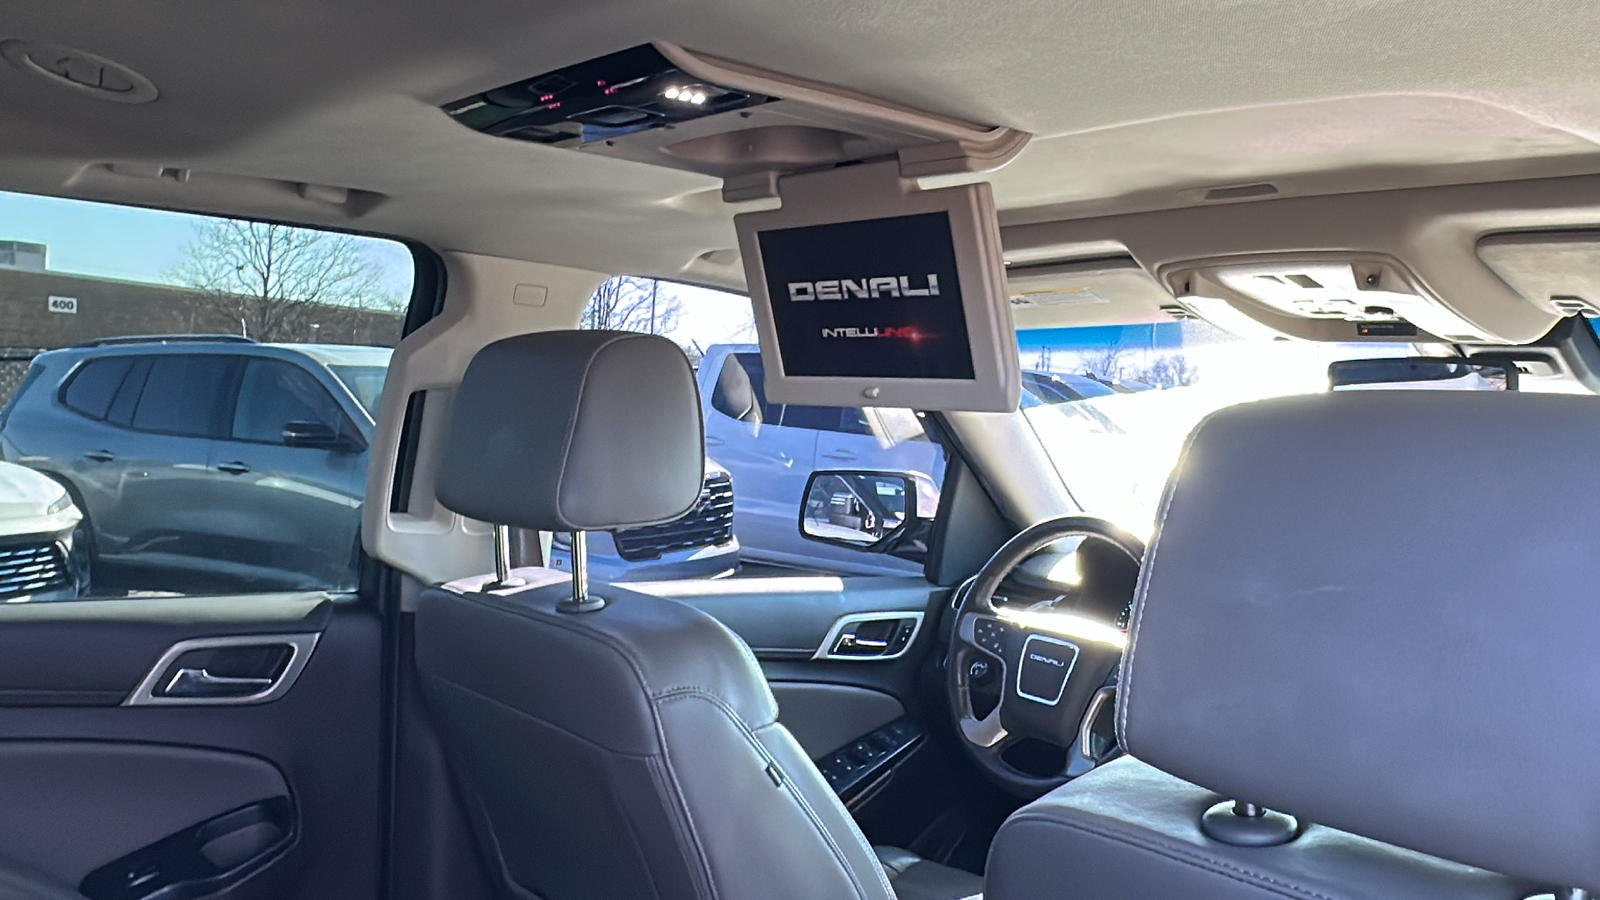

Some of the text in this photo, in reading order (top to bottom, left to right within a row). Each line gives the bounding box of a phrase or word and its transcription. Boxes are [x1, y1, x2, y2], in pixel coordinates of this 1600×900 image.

[787, 273, 940, 302] DENALI
[51, 299, 75, 310] 400
[1030, 653, 1065, 667] DENALI
